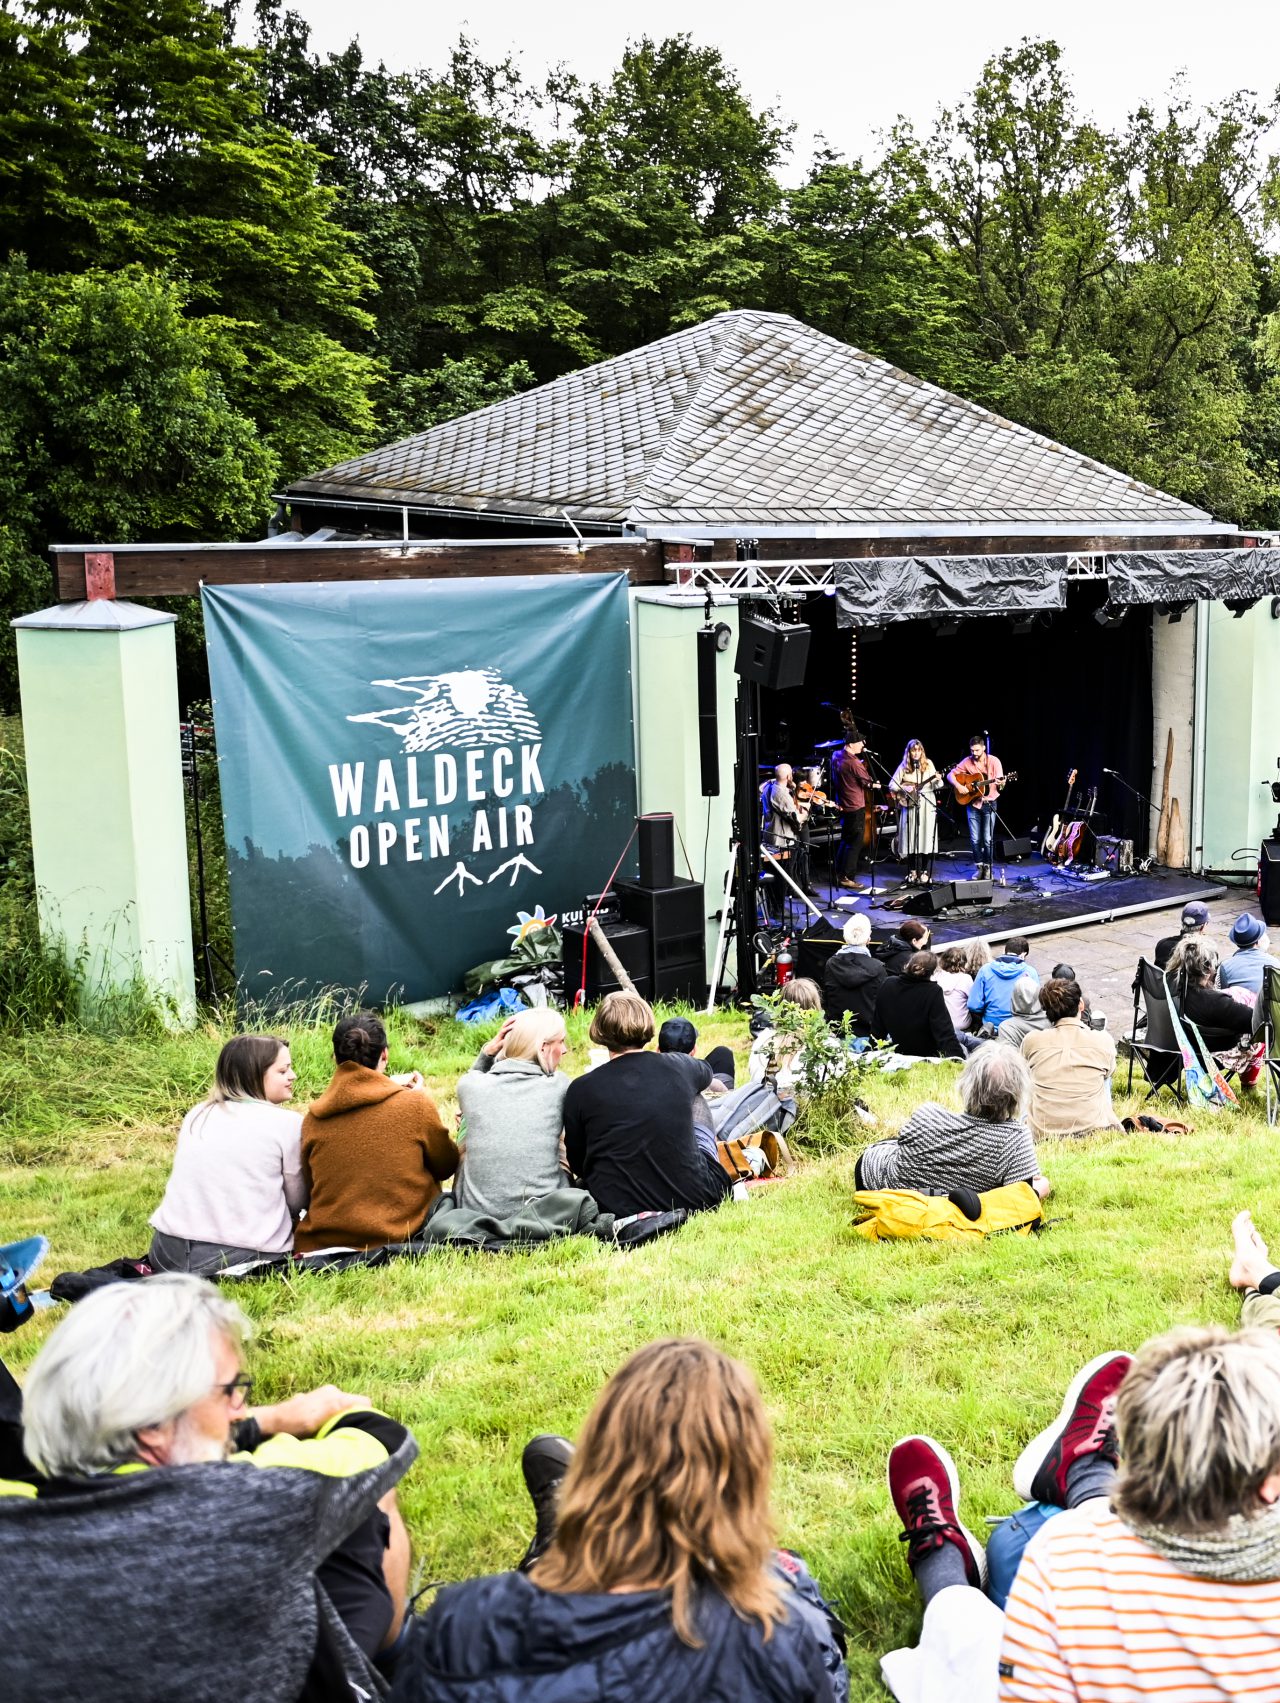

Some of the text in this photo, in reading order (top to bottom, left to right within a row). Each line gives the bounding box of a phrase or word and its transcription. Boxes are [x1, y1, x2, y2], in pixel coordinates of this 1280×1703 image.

[328, 743, 545, 818] WALDECK
[349, 804, 535, 869] OPEN AIR
